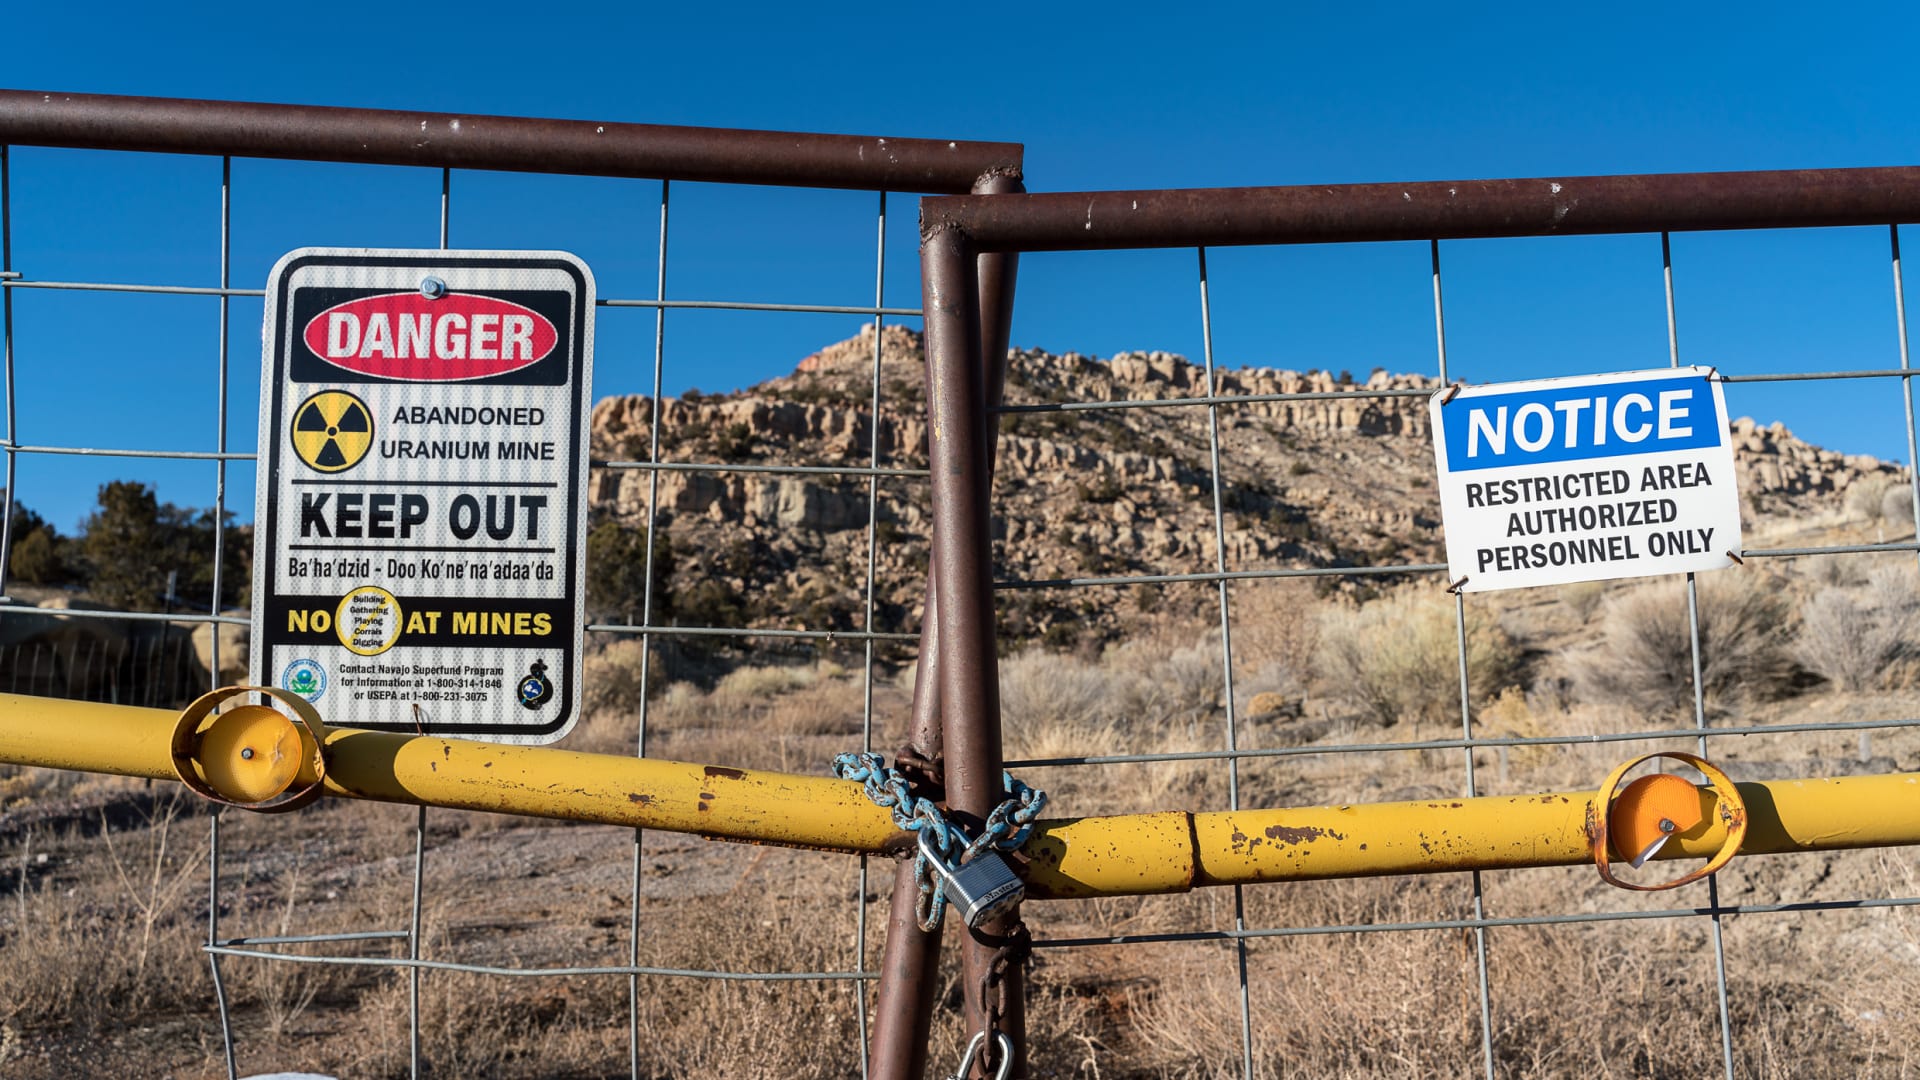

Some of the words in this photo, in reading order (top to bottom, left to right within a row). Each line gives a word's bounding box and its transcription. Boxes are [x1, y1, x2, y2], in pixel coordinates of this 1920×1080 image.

[326, 311, 535, 361] DANGER
[392, 406, 545, 426] ABANDONED
[1467, 389, 1693, 459] NOTICE
[380, 440, 490, 460] URANIUM
[497, 441, 555, 461] MINE
[1465, 469, 1631, 508] RESTRICTED
[1640, 462, 1712, 492] AREA
[300, 492, 429, 539] KEEP
[449, 493, 547, 541] OUT
[1506, 498, 1678, 538] AUTHORIZED
[1476, 535, 1640, 573] PERSONNEL
[1647, 527, 1715, 558] ONLY
[387, 558, 416, 579] Doo
[353, 595, 386, 605] Building
[350, 605, 389, 616] Gathering
[287, 609, 331, 633] NO
[354, 616, 384, 626] Playing
[406, 611, 441, 634] AT
[452, 611, 552, 636] MINES
[354, 627, 383, 636] Corrals
[353, 638, 384, 648] Digging
[339, 663, 376, 674] Contact
[378, 664, 410, 676] Navajo
[412, 665, 461, 677] Superfund
[464, 665, 504, 677] Program
[341, 676, 354, 687] for
[414, 678, 424, 688] at
[354, 691, 365, 700] or
[367, 690, 398, 700] USEPA
[400, 691, 410, 701] at
[413, 691, 488, 702] 1-800-231-3075
[984, 882, 1015, 902] Master
